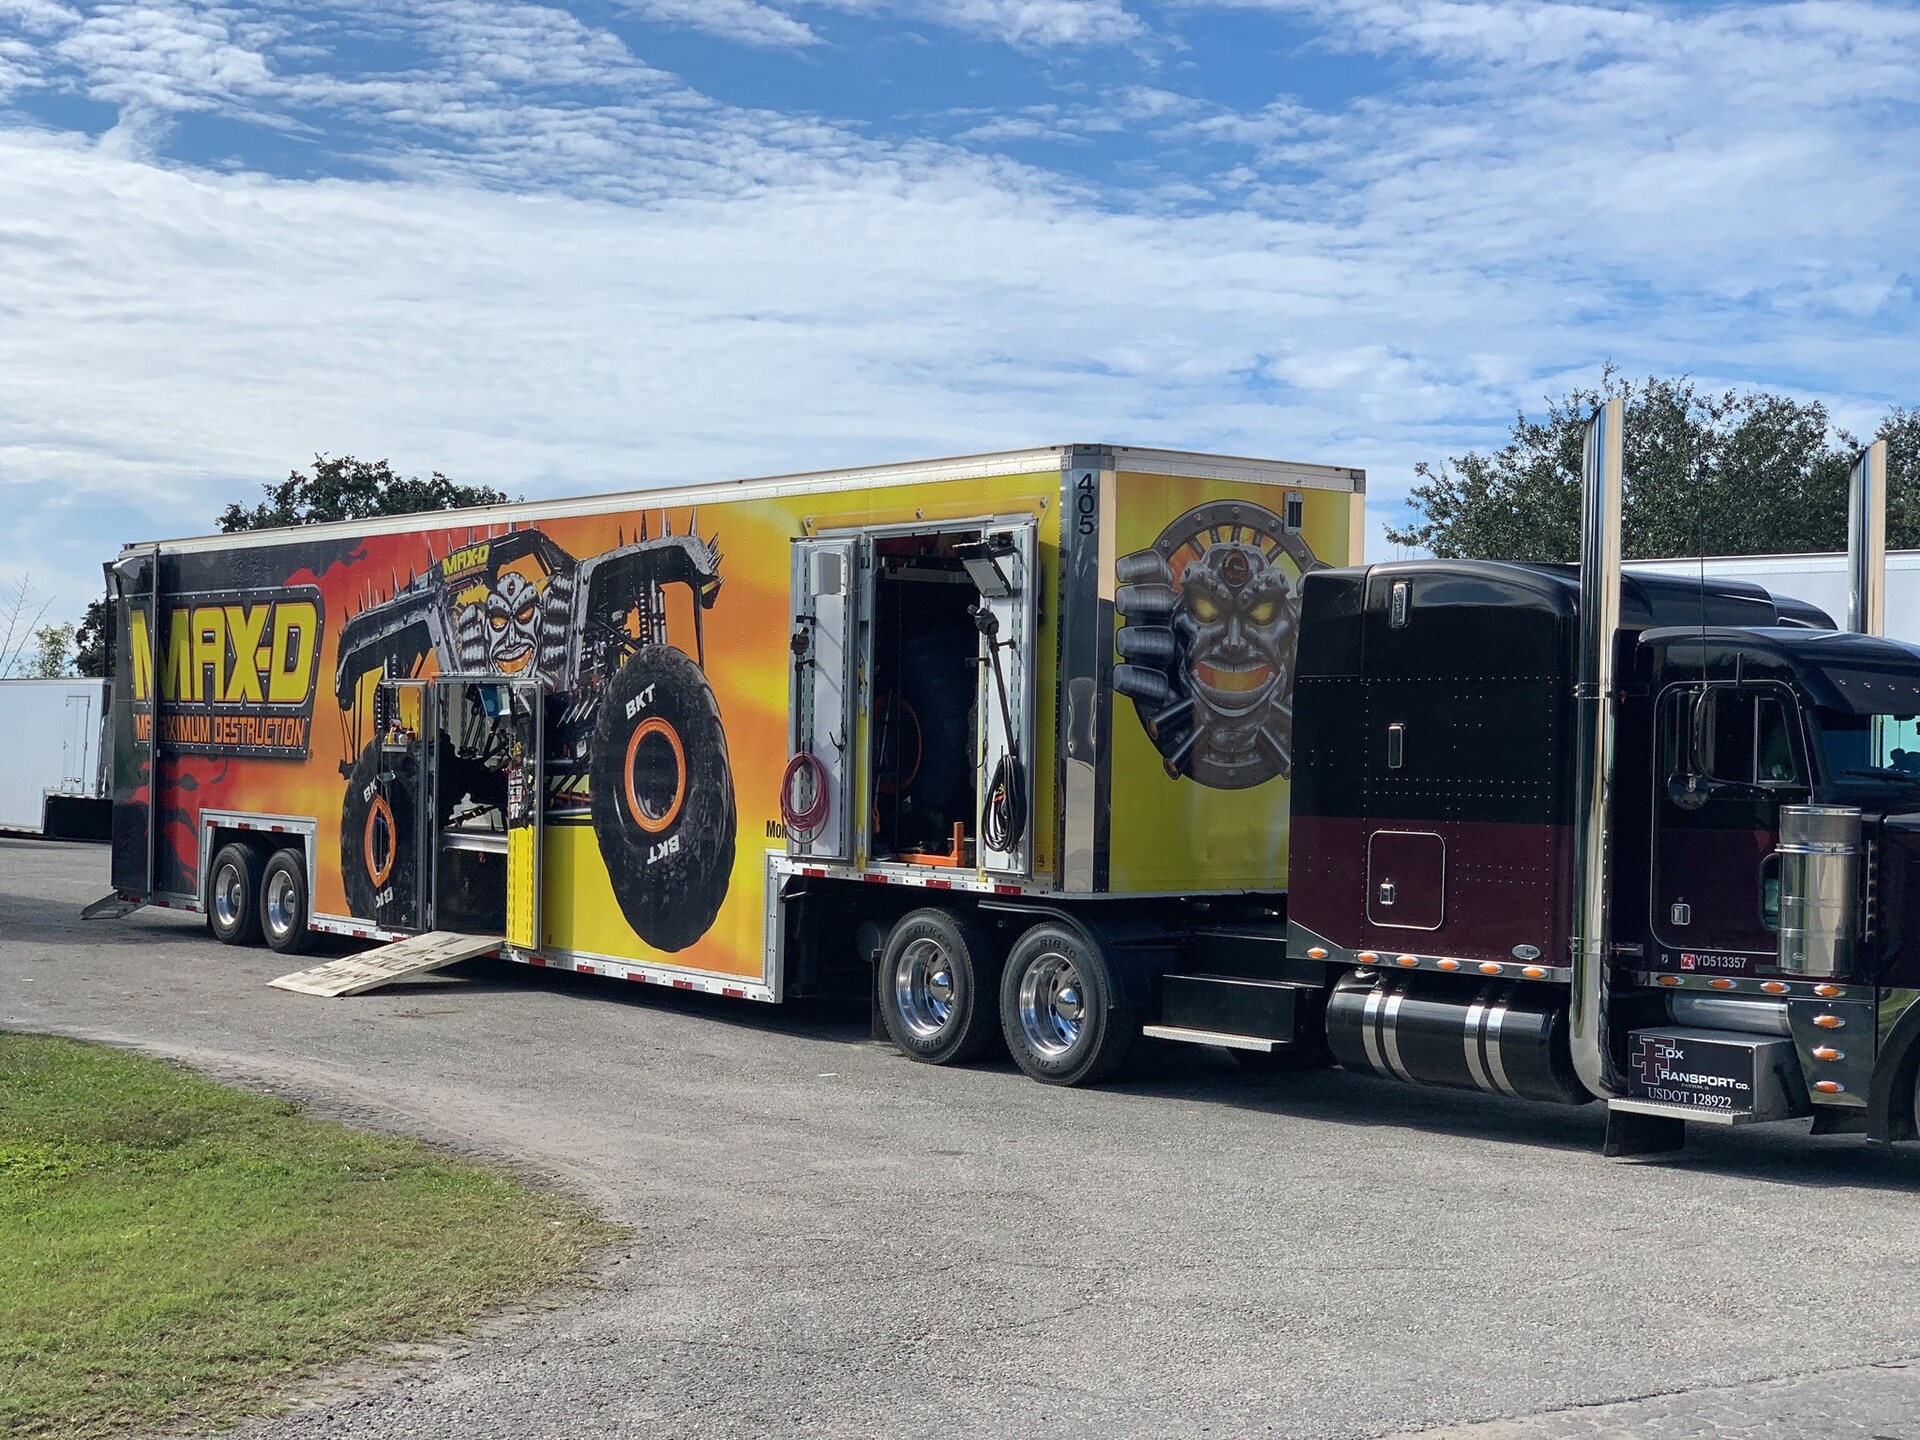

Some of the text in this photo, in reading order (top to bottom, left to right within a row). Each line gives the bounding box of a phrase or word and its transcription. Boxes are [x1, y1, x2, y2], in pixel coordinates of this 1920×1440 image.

[1077, 472, 1095, 535] 405
[441, 544, 490, 576] MAX-D
[131, 602, 318, 702] MAX-D
[625, 682, 655, 720] BKT
[214, 715, 305, 748] DESTRUCTION
[363, 776, 378, 803] BK
[766, 820, 787, 839] Mon
[647, 834, 680, 865] BKT
[375, 886, 394, 909] BK
[1695, 954, 1747, 969] YD513357
[1647, 1087, 1732, 1109] USDOT 128922
